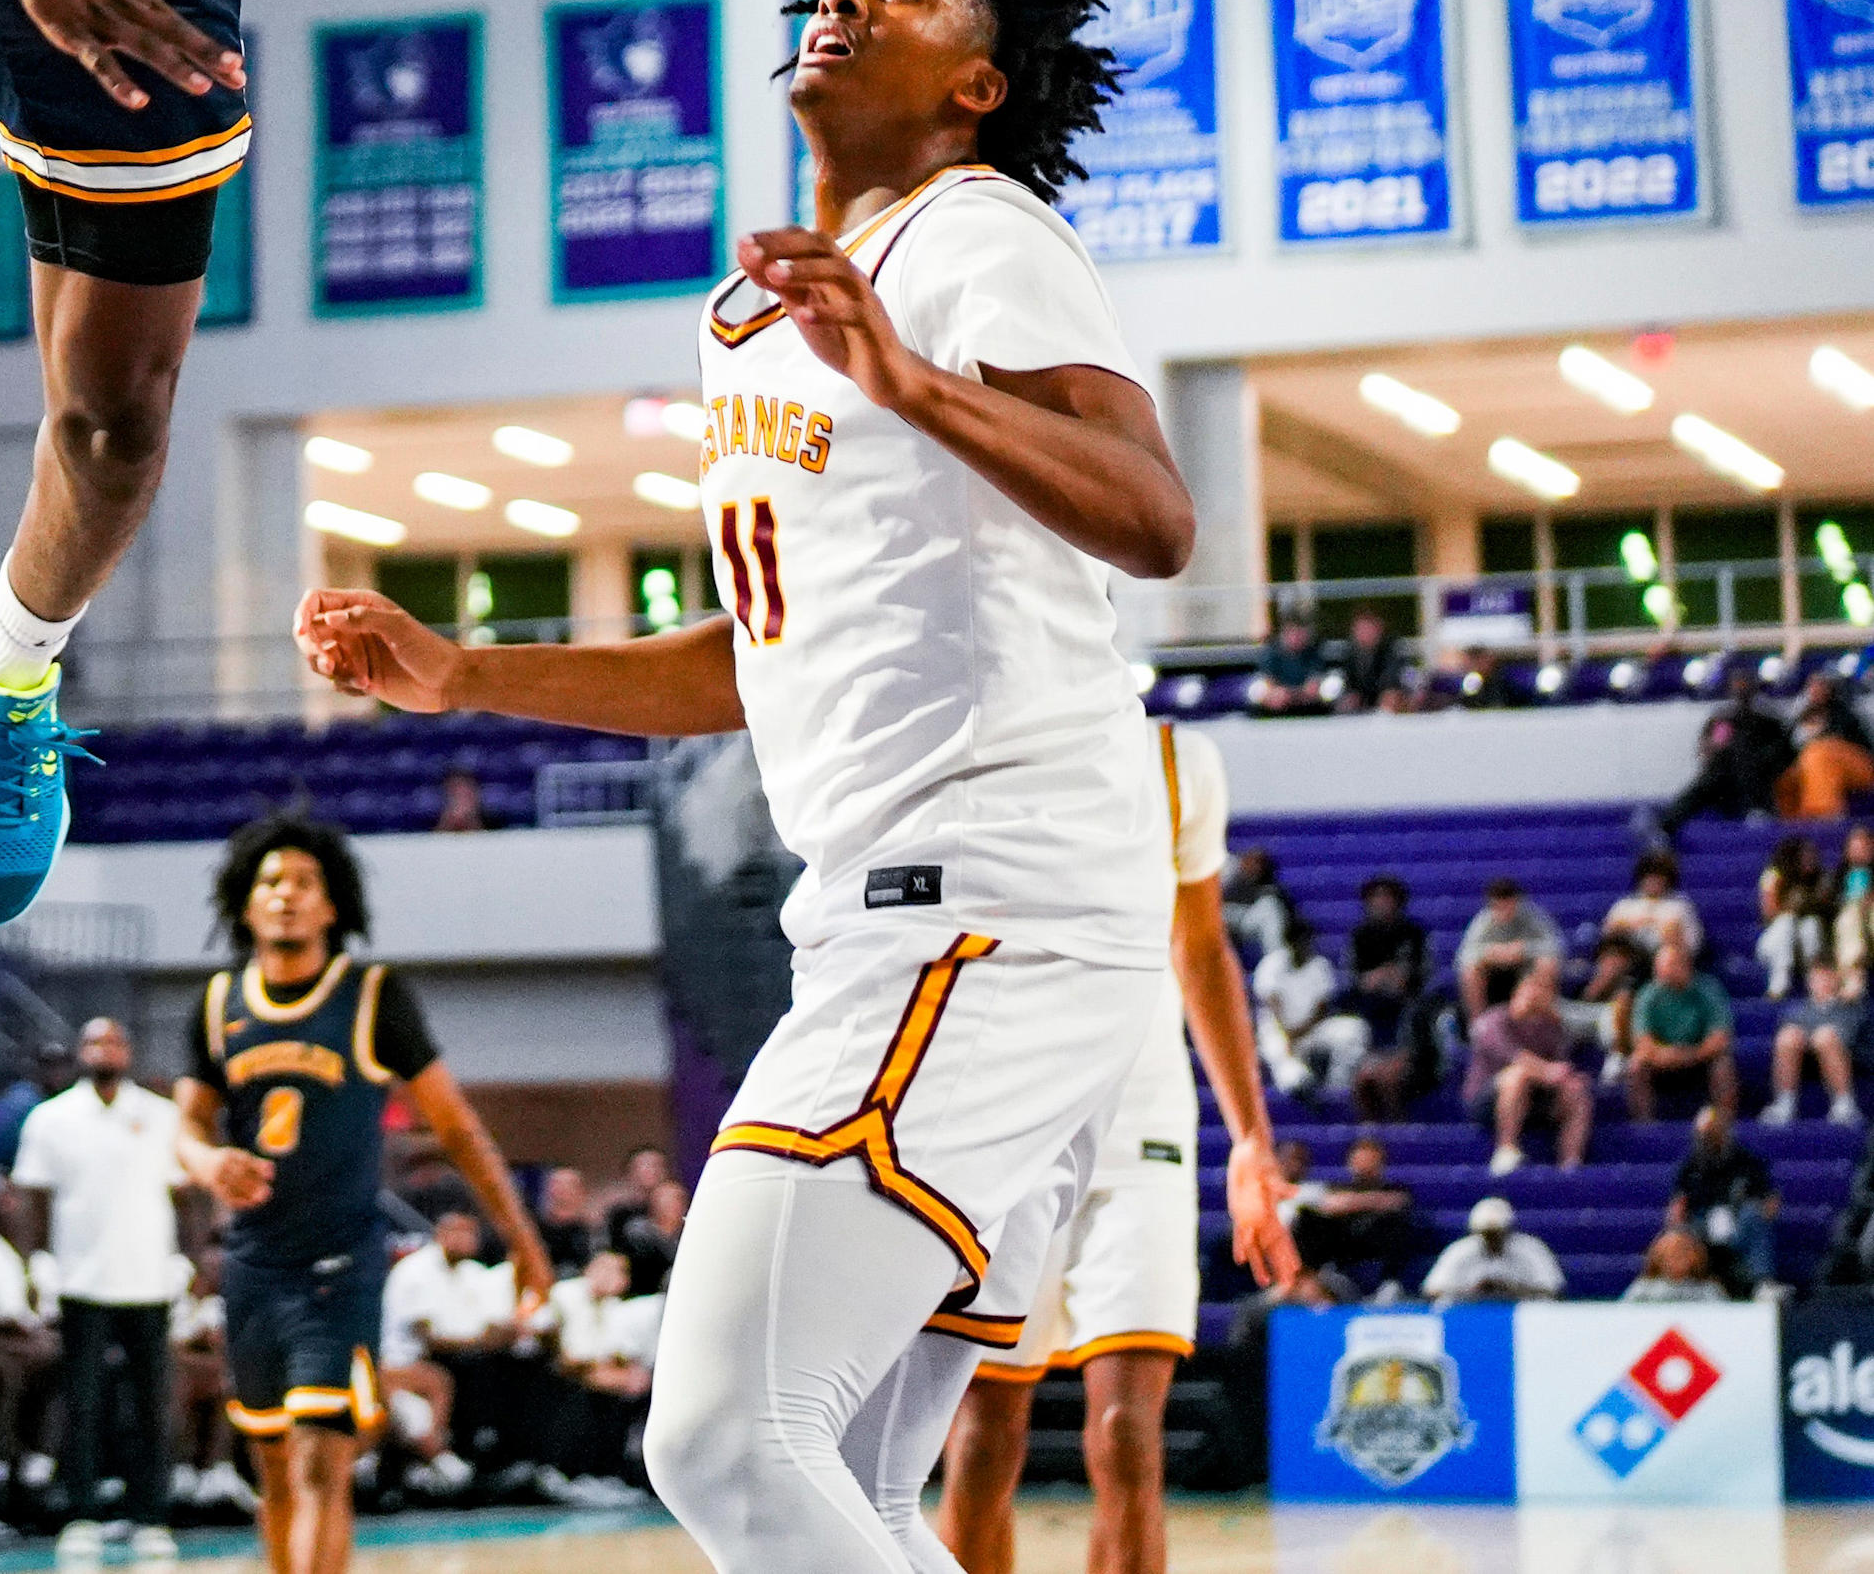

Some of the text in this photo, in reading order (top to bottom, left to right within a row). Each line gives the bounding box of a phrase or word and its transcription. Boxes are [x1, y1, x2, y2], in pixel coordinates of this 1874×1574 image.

[1298, 175, 1428, 236] 2021
[1535, 153, 1675, 212] 2022
[699, 393, 832, 476] STANGS
[720, 495, 785, 647] 11
[912, 875, 930, 893] XL
